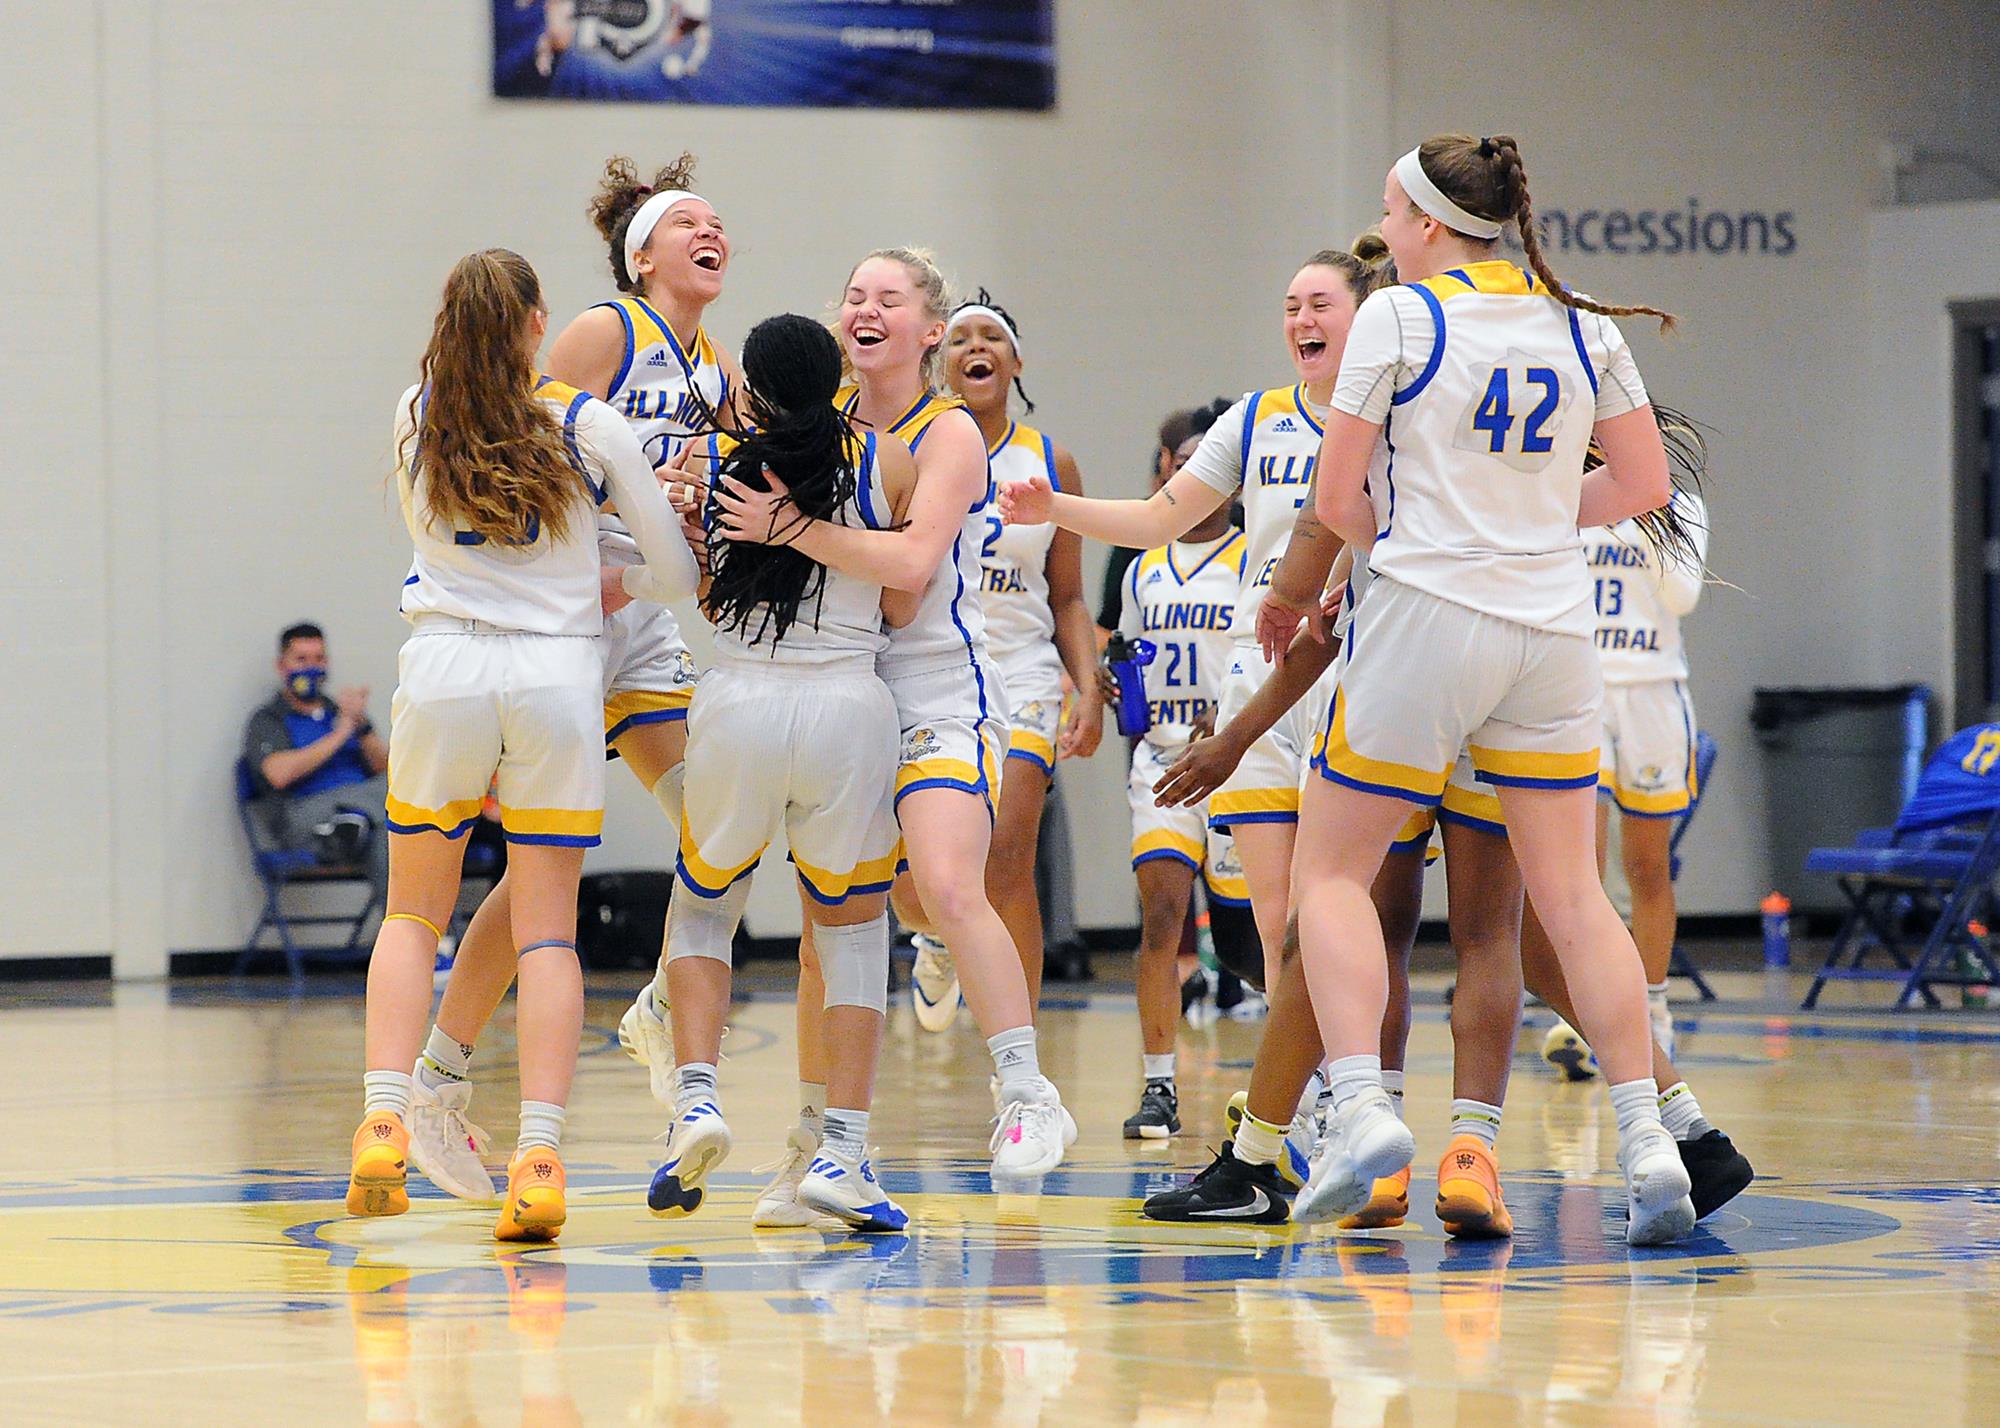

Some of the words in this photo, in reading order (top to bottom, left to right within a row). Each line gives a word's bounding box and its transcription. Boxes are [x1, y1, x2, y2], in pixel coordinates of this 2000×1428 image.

[1503, 197, 1797, 256] ncessions
[625, 389, 714, 432] ILLINO
[1473, 366, 1560, 454] 42
[1259, 455, 1315, 486] ILLI
[980, 564, 1028, 592] TRAL
[1595, 579, 1623, 616] 13
[1142, 603, 1235, 632] LLINOIS
[1595, 628, 1660, 652] TRAL
[1165, 642, 1198, 687] 21
